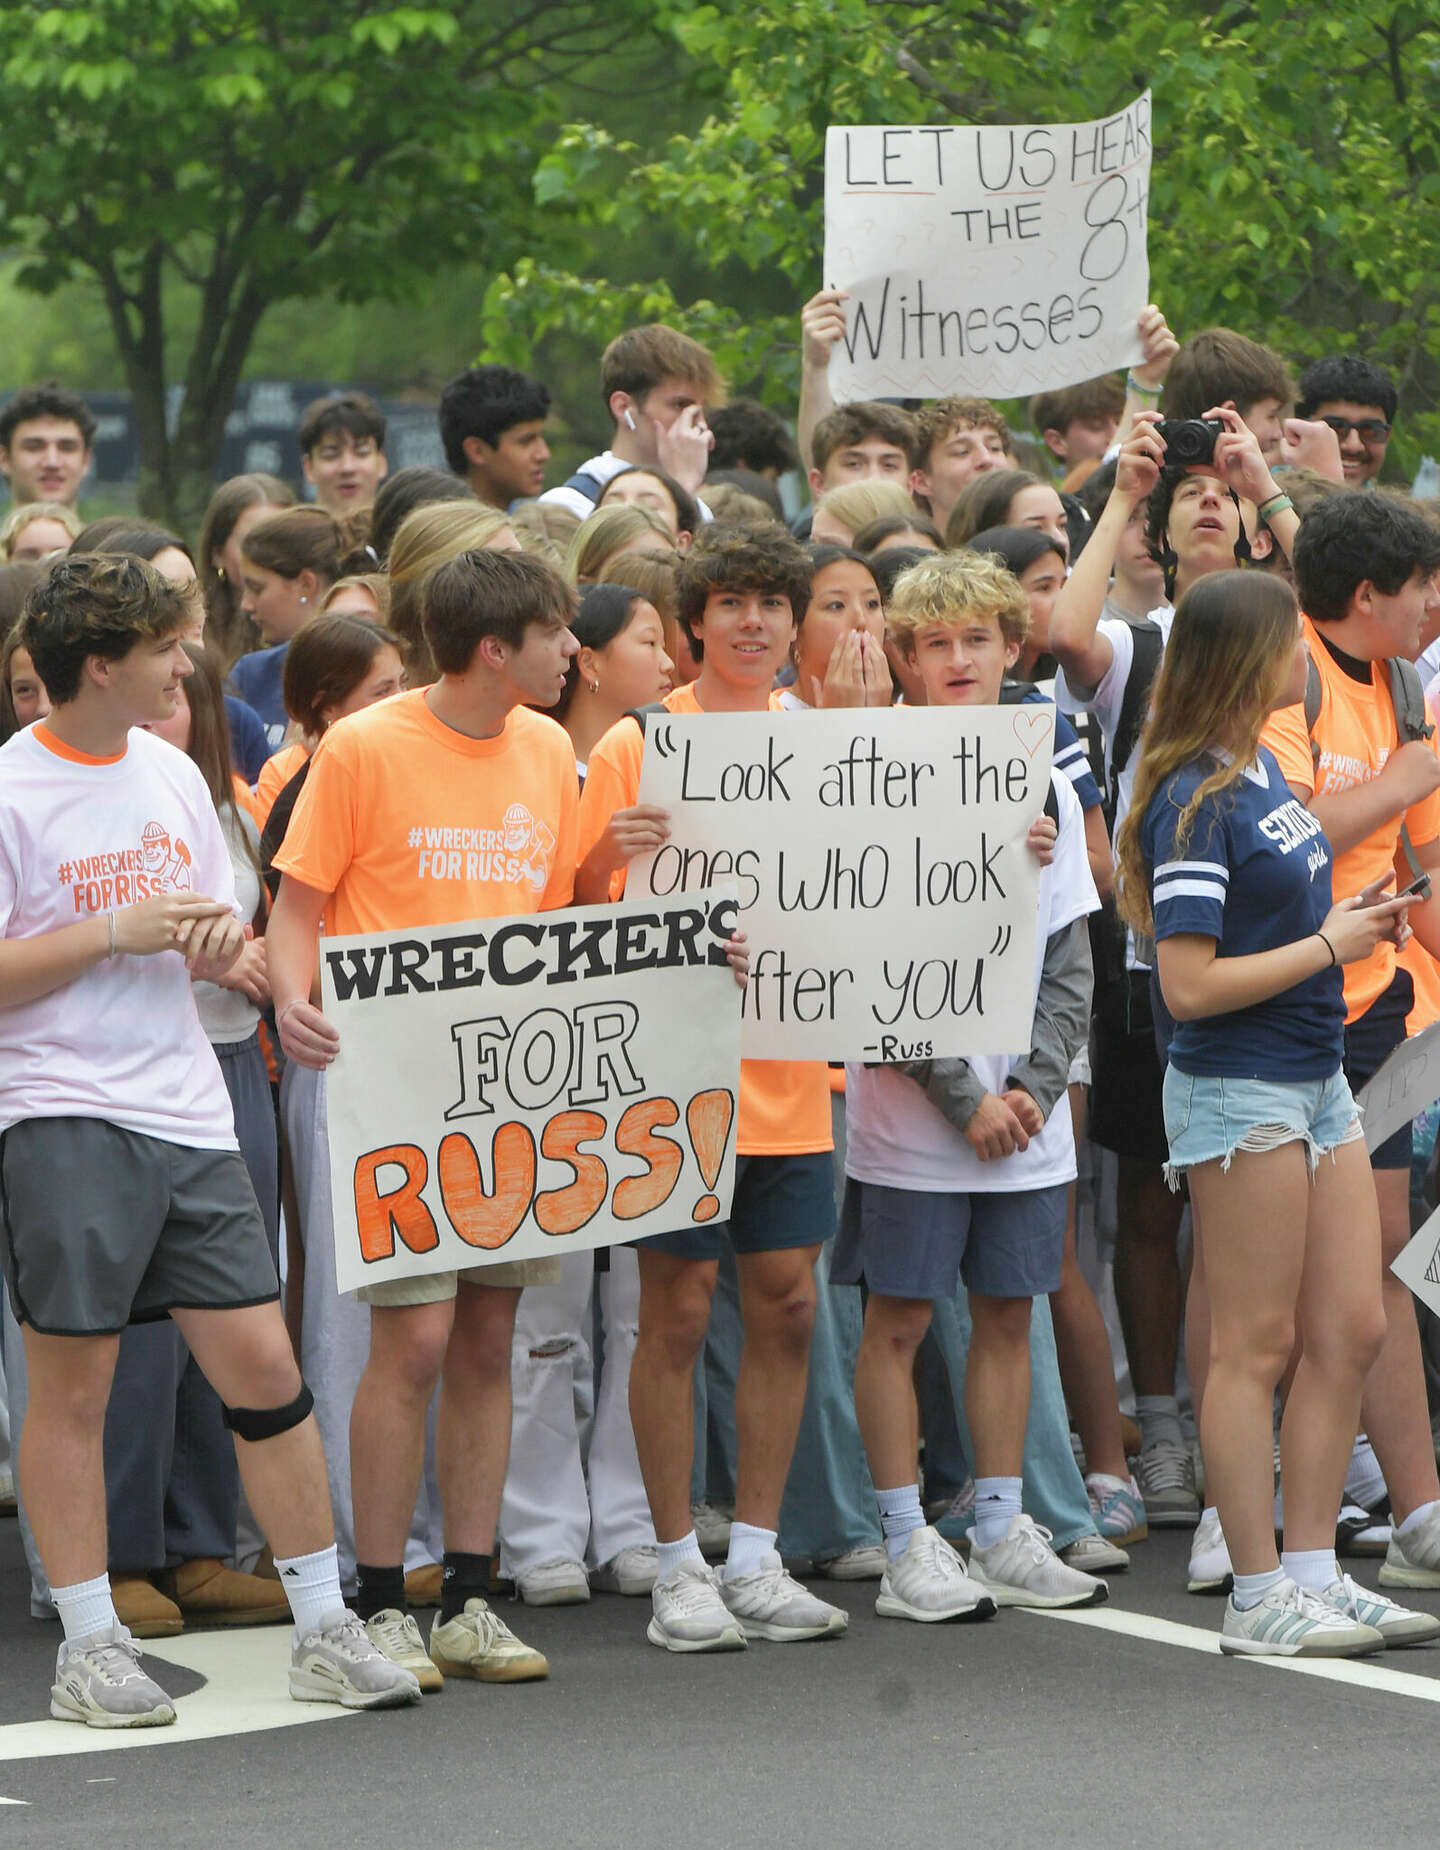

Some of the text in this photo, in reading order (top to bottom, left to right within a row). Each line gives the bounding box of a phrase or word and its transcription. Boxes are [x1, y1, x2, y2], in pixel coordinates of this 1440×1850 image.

[846, 98, 1150, 191] LET US HEAR
[951, 202, 1041, 243] THE
[831, 277, 1103, 364] Witnesses
[818, 735, 935, 809] after
[952, 735, 1029, 806] the
[1320, 772, 1356, 794] FO
[407, 825, 506, 852] #WRECKERS
[418, 849, 522, 884] FOR RUSS
[915, 832, 1007, 907] look
[73, 877, 113, 913] FOR
[325, 899, 739, 1001] WRECKER'S
[741, 949, 855, 1023] fter
[443, 1000, 647, 1122] FOR
[353, 1088, 735, 1264] RUSS!
